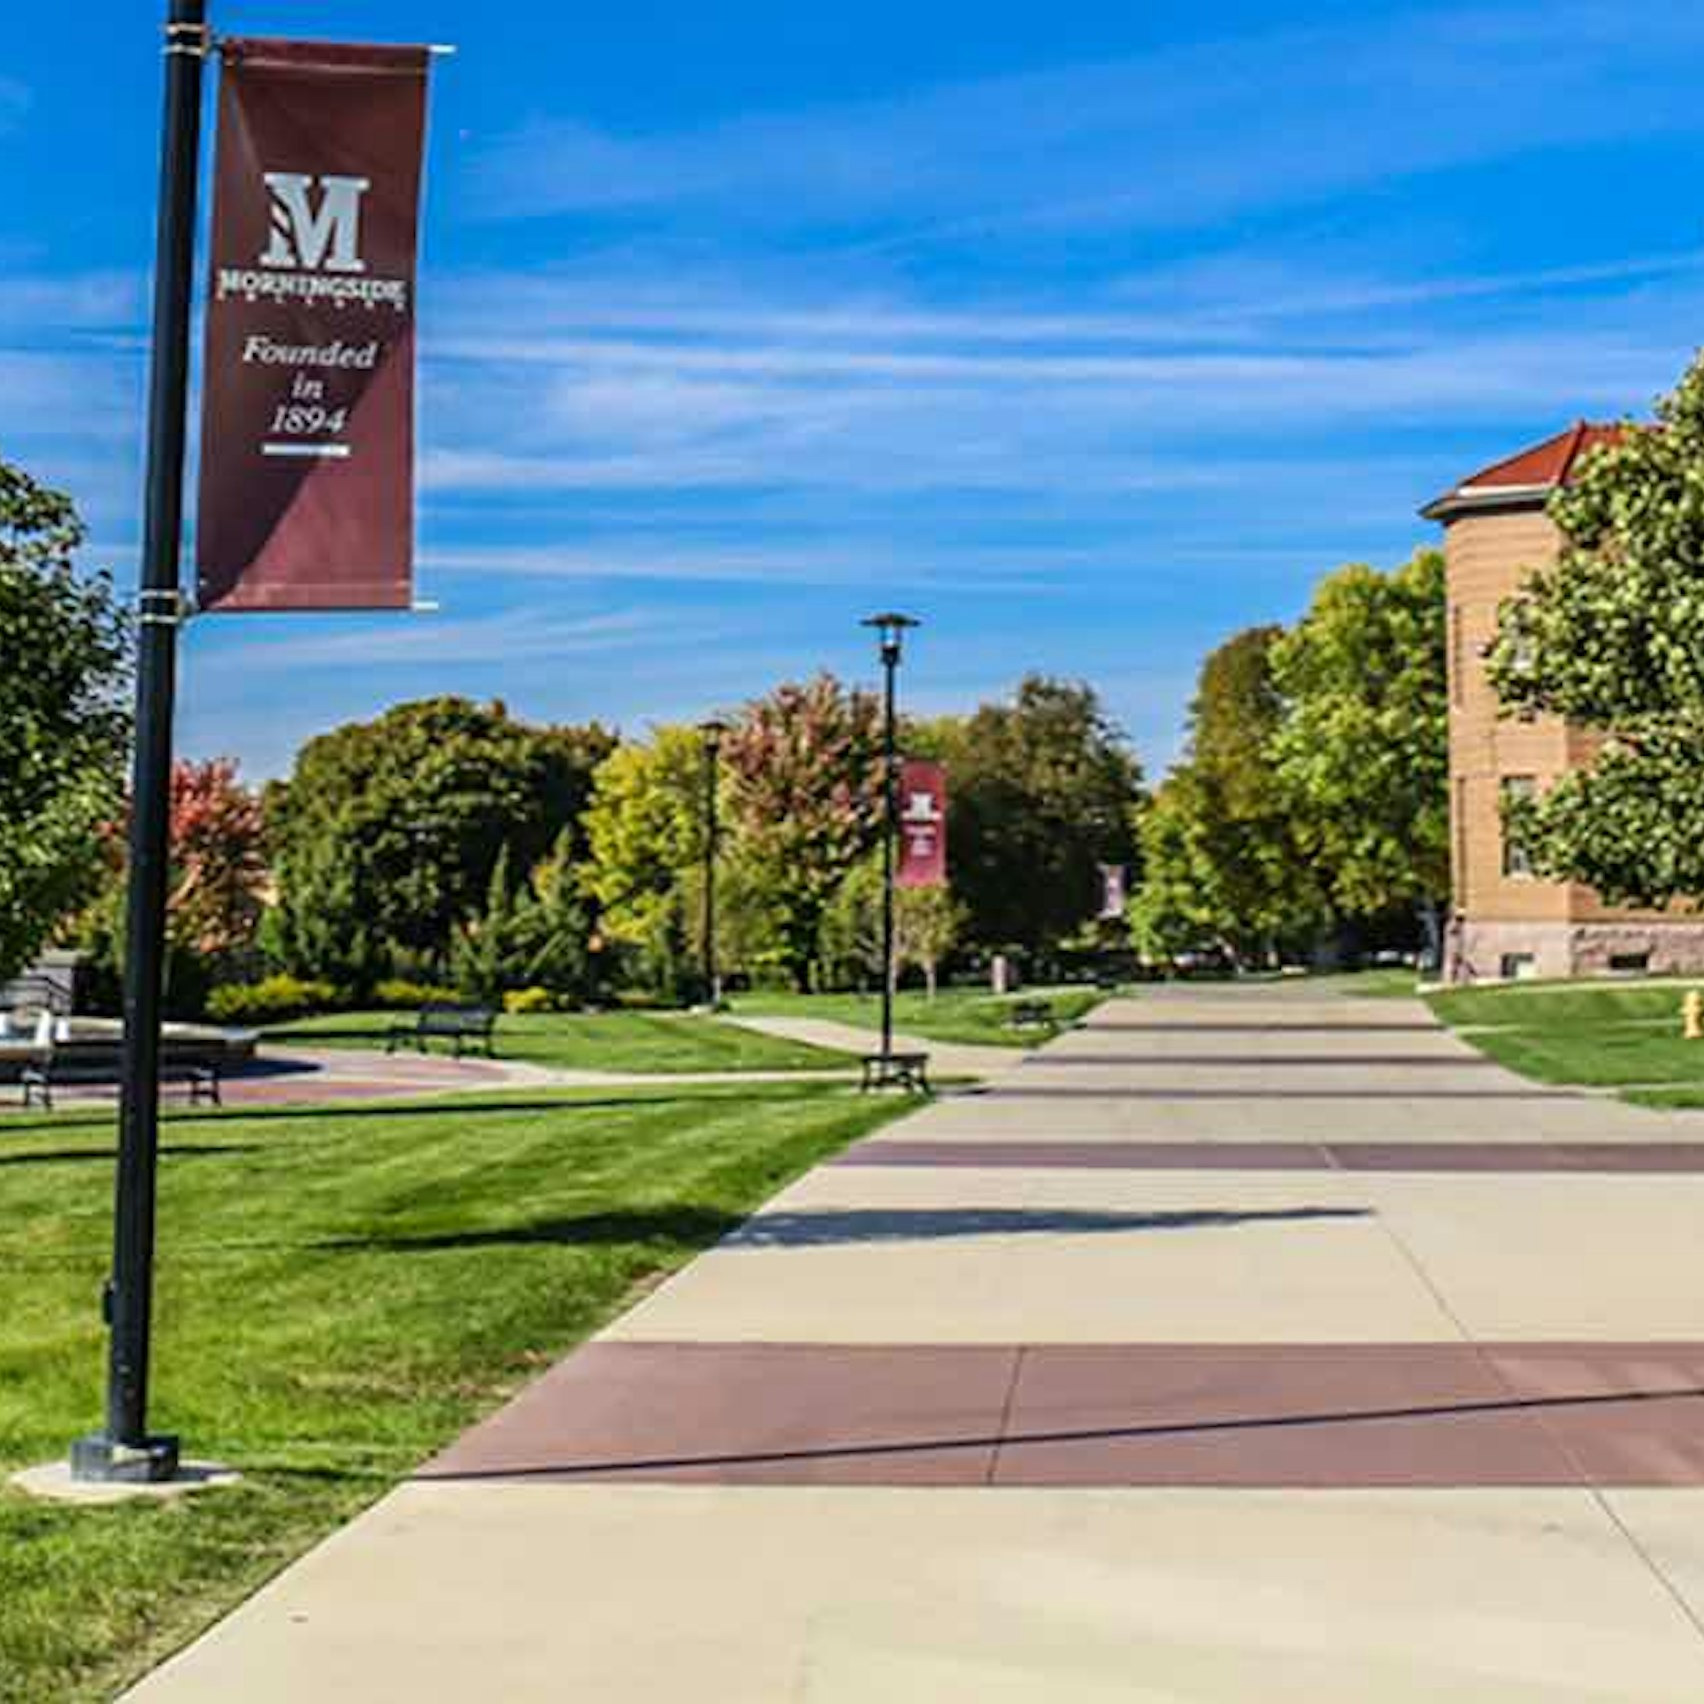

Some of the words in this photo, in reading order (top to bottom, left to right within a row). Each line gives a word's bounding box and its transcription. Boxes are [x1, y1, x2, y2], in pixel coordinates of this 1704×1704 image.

[259, 172, 370, 272] M
[219, 269, 407, 303] MORNINGSIDE
[242, 335, 378, 367] Founded
[292, 373, 324, 400] in
[271, 406, 346, 433] 1894
